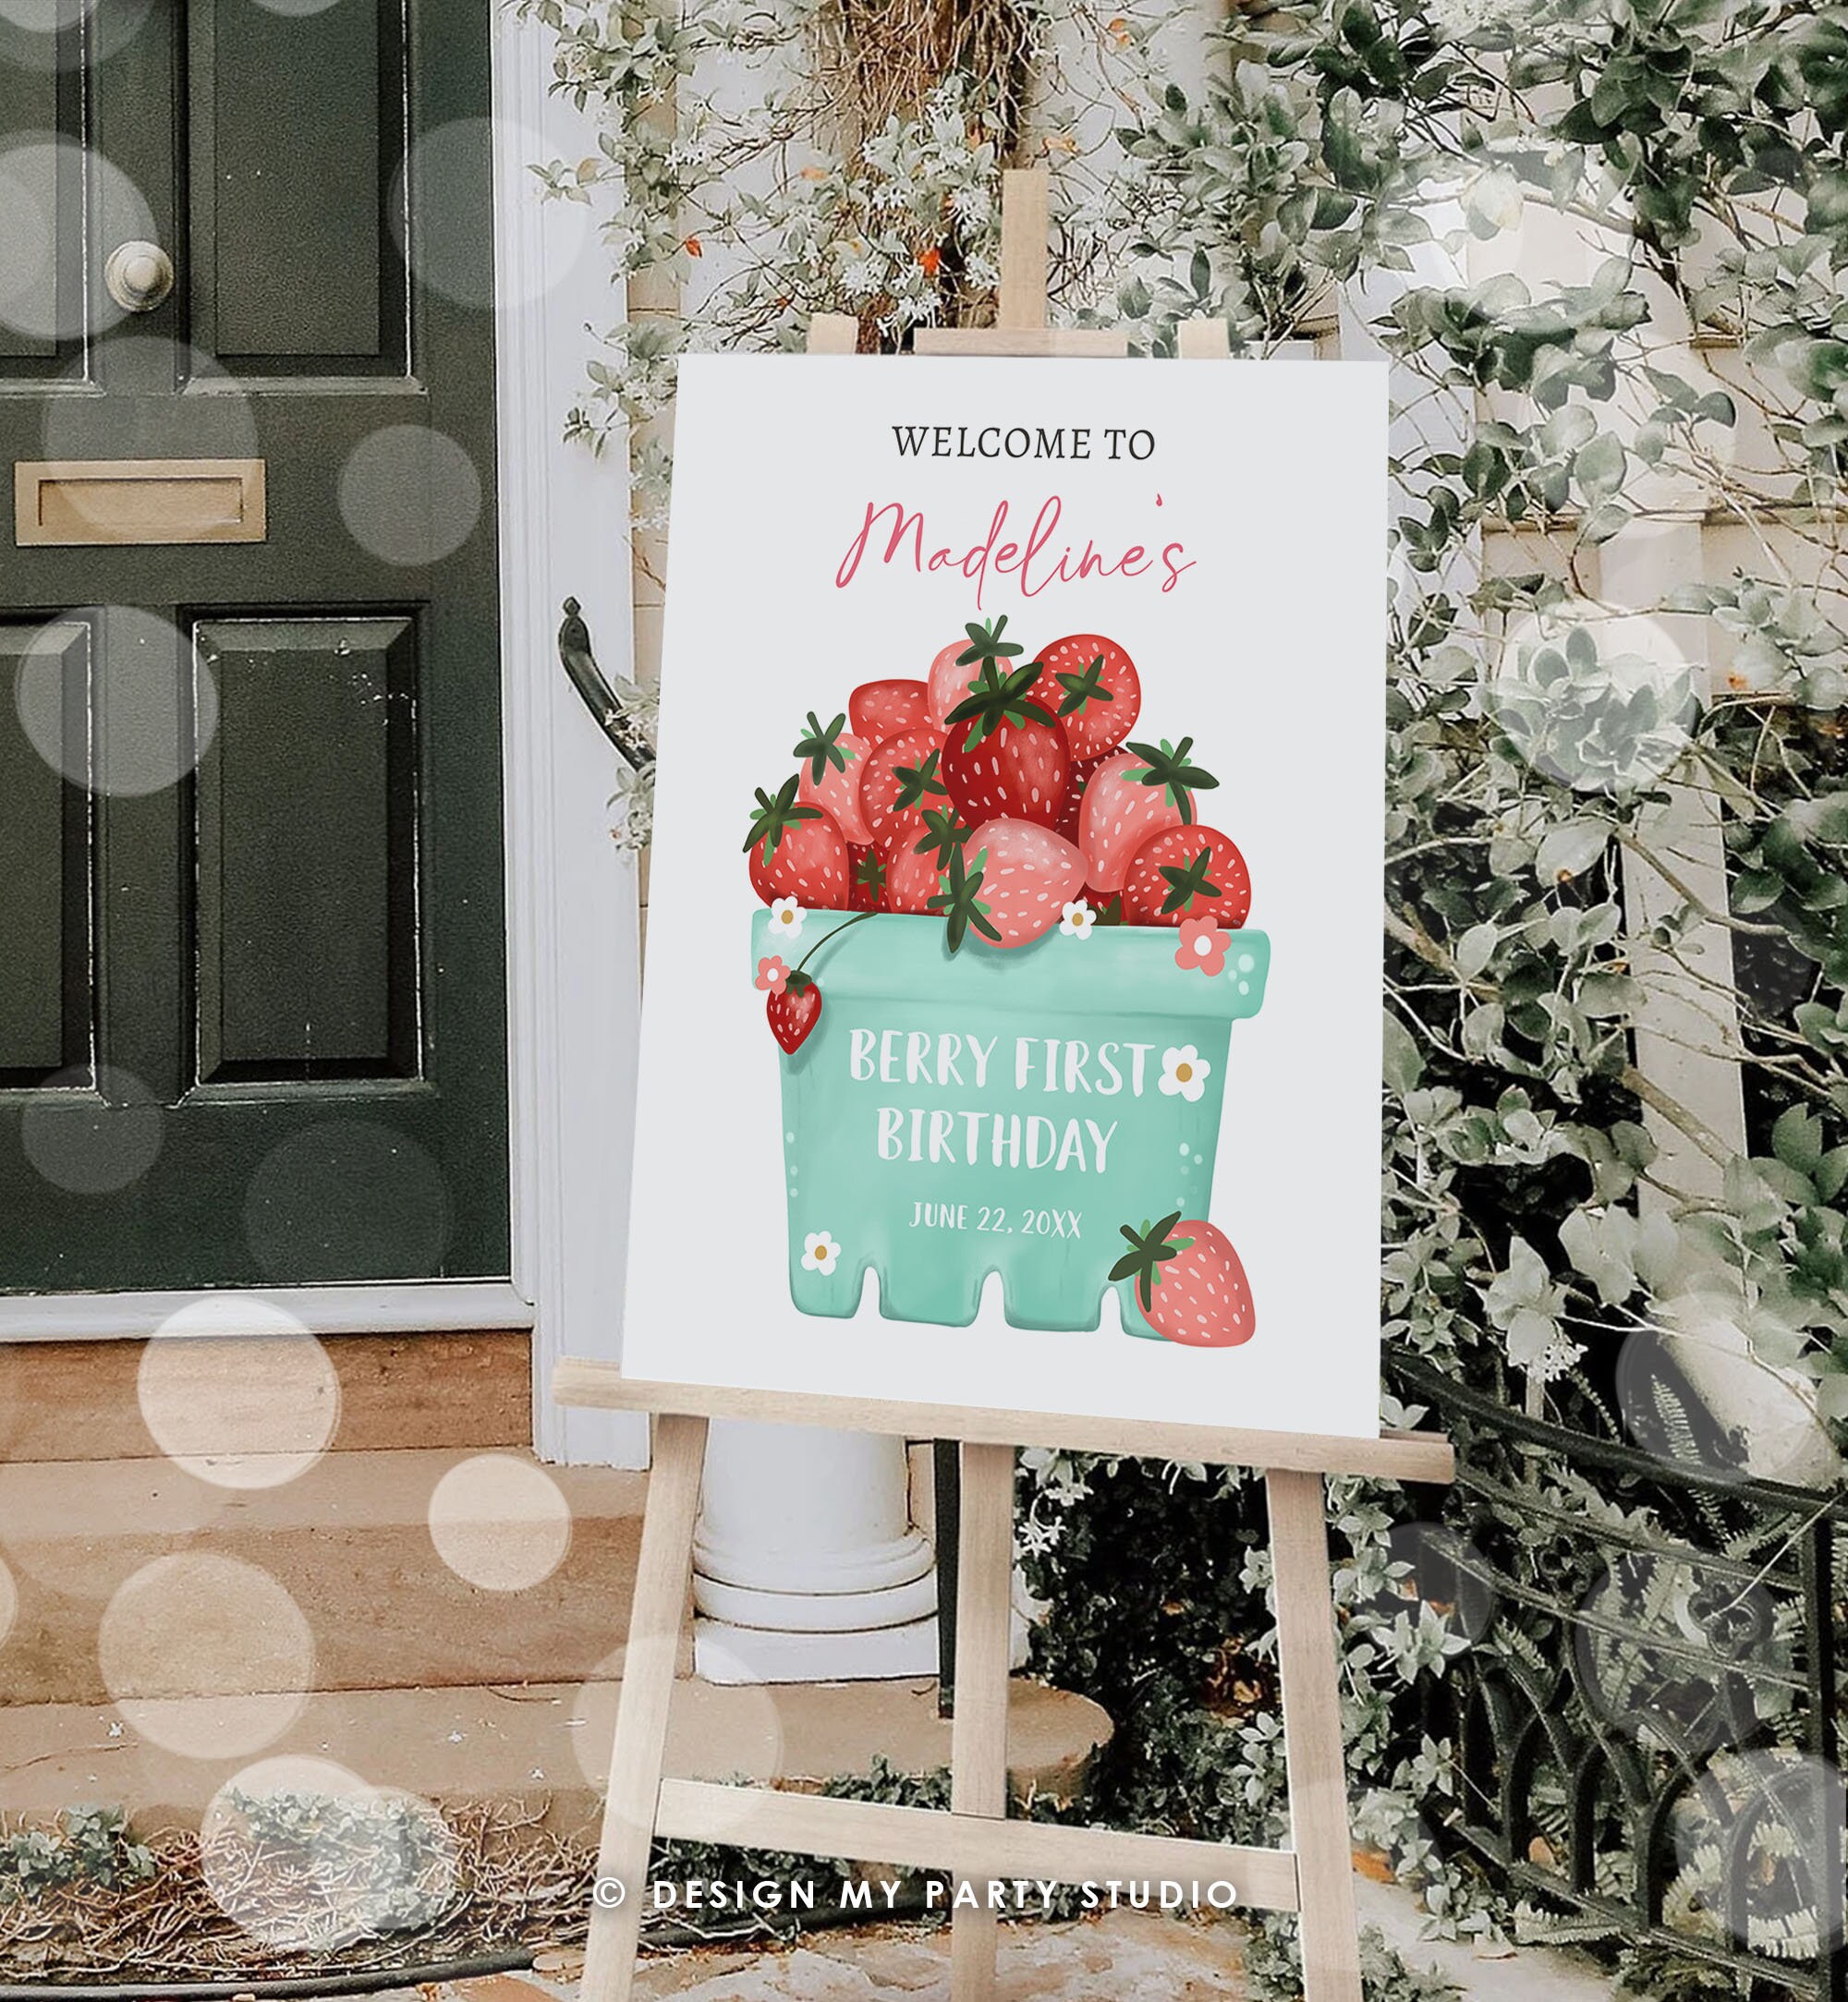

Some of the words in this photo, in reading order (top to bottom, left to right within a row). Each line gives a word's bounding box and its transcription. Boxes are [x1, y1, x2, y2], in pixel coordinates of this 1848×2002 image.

[892, 425, 1091, 459] WELCOME
[1103, 429, 1155, 460] TO
[835, 492, 1197, 611] Madeline's
[849, 1028, 997, 1088] BERRY
[1015, 1037, 1156, 1097] FIRST
[876, 1107, 1117, 1173] BIRTHDAY
[909, 1202, 967, 1230] JUNE
[977, 1207, 1013, 1234] 22,
[1023, 1210, 1082, 1239] 20XX
